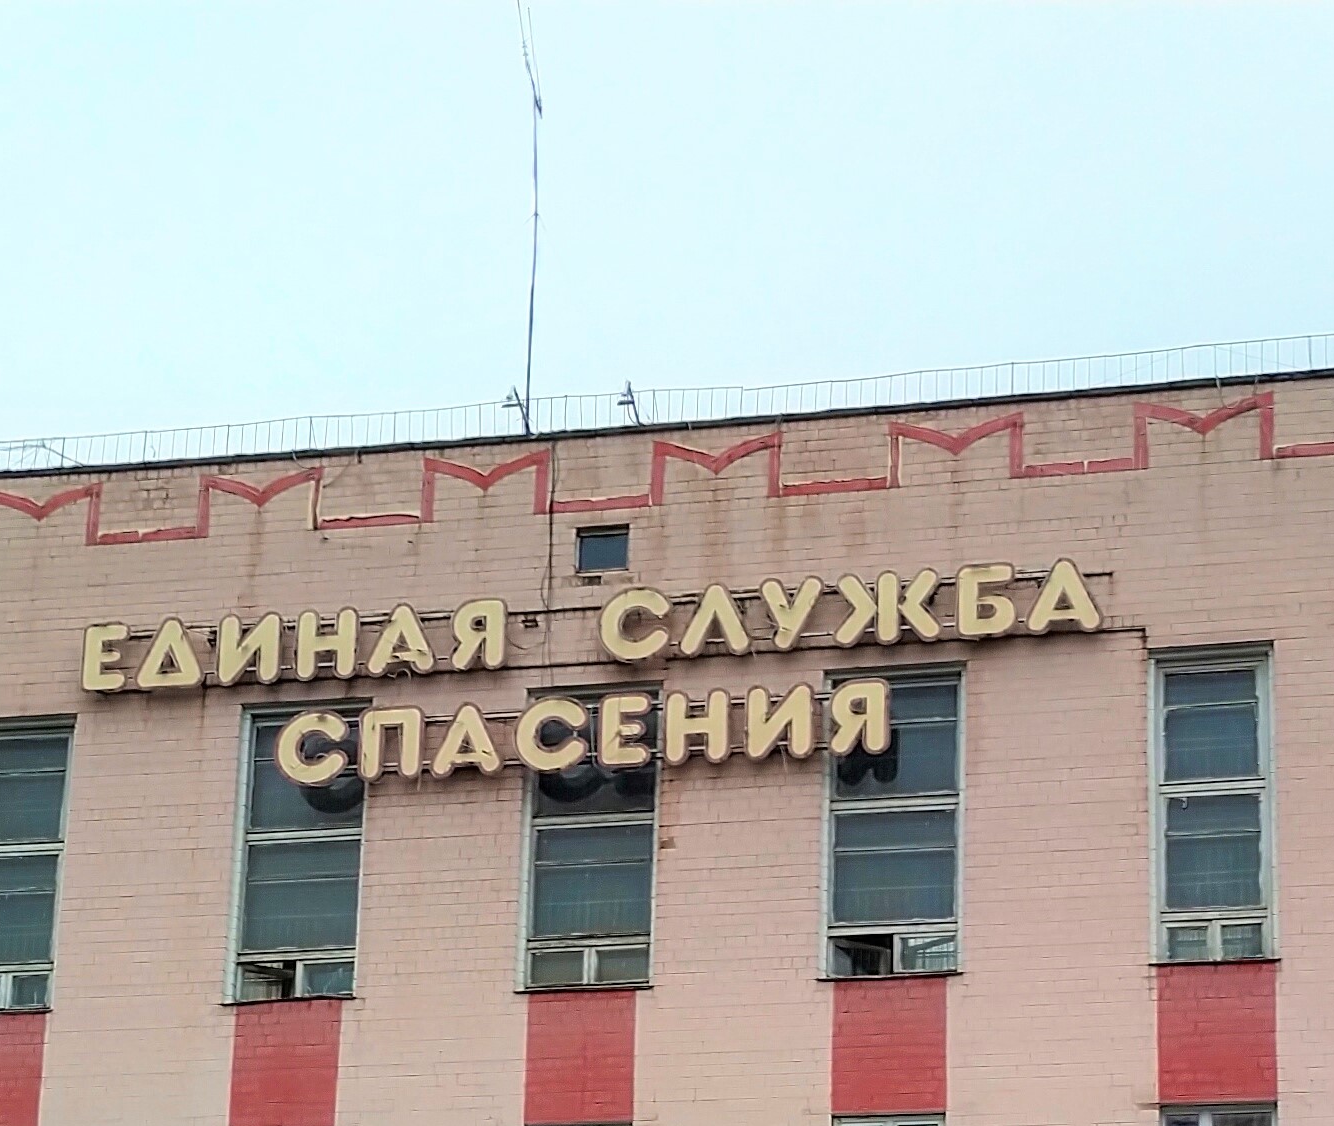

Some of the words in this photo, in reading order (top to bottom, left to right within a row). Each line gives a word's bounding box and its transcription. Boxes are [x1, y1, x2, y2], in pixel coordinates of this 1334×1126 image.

[80, 597, 509, 692] ЕДИНАЯ
[597, 556, 1105, 664] СЛУЖБА
[273, 676, 892, 788] СПАСЕНИЯ
